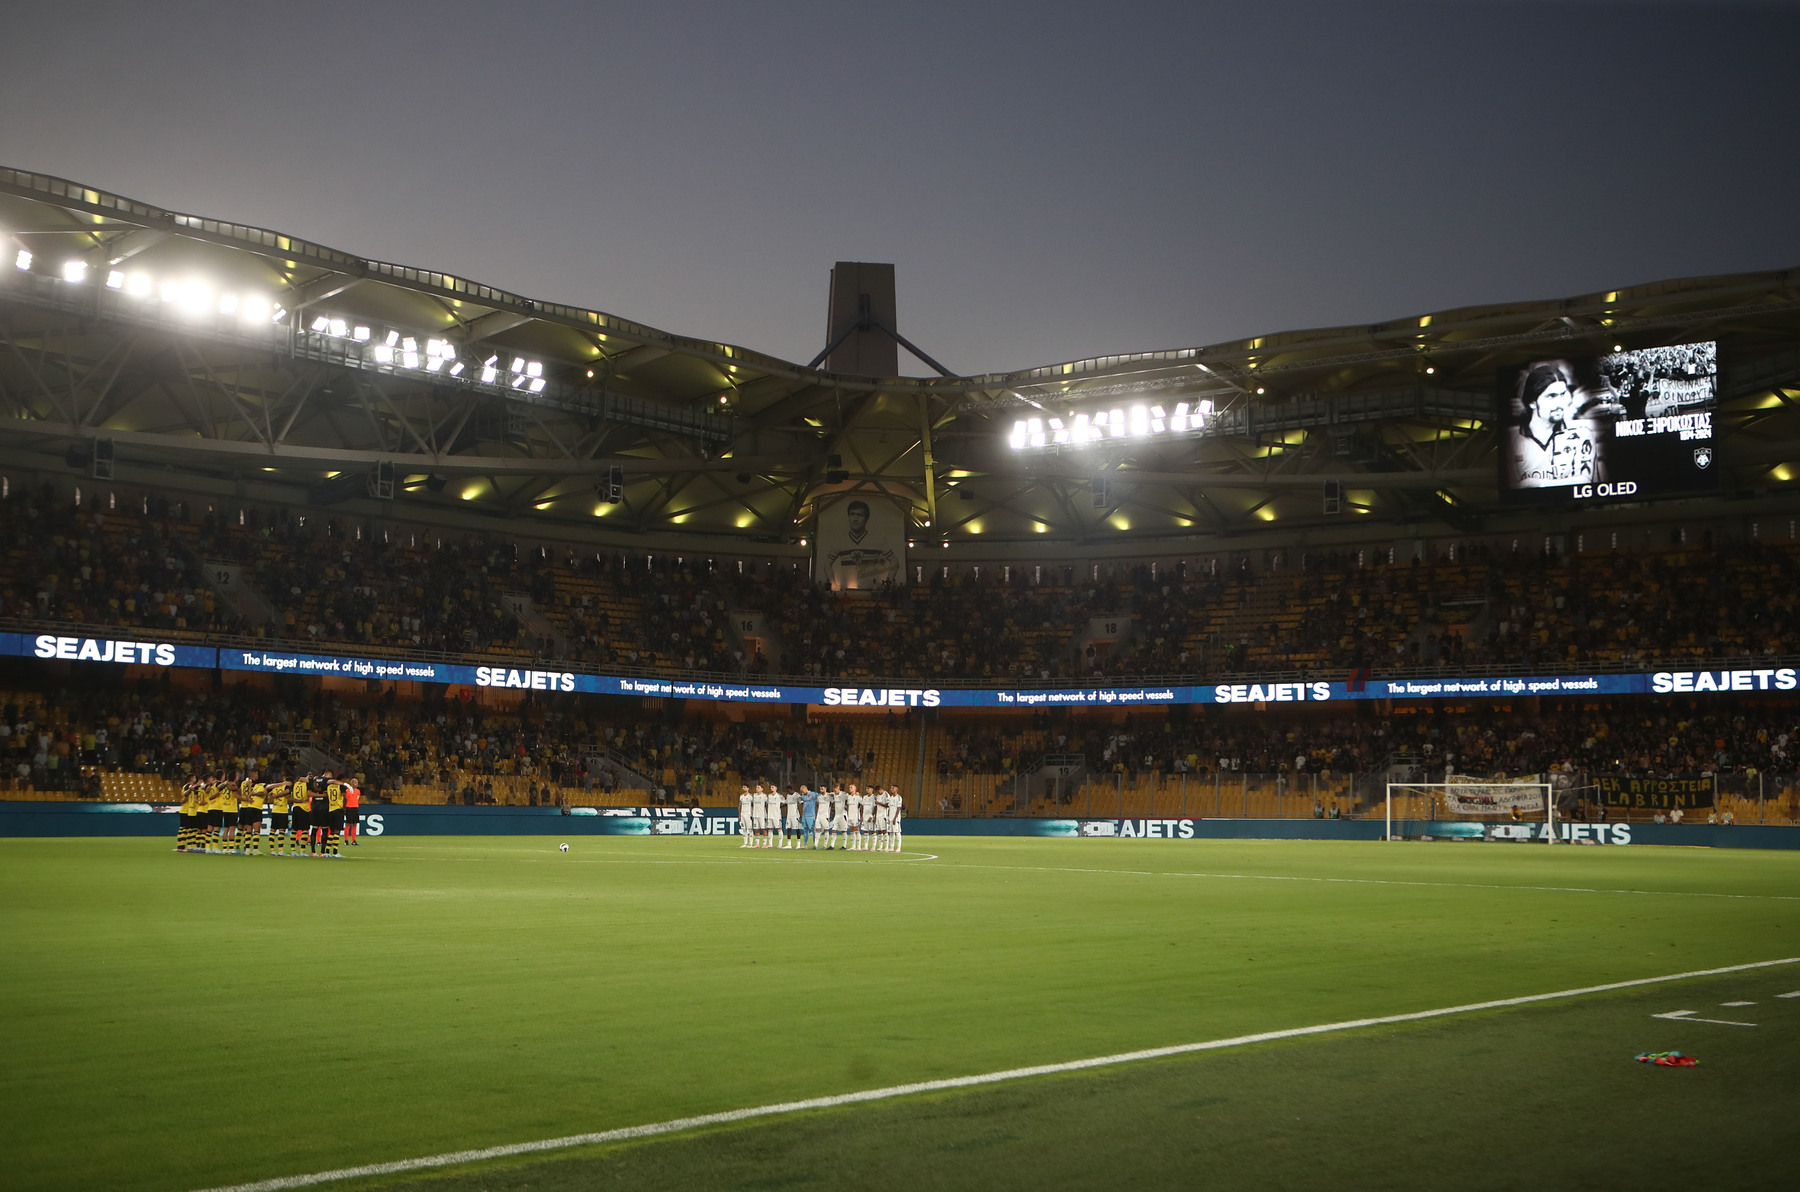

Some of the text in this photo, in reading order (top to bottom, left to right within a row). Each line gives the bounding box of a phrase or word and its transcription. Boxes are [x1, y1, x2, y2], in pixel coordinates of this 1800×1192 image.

[1615, 413, 1712, 437] ΝΙΚΟΣ ΞΗΡΟΚΩΣΤΑΣ
[1573, 481, 1637, 499] LG OLED
[216, 571, 230, 585] 12
[741, 620, 753, 631] 16
[1105, 622, 1117, 634] 18
[35, 635, 175, 666] SEAJETS
[243, 653, 435, 677] The largest network of high speed vessels
[475, 666, 575, 692] SEAJETS
[1387, 678, 1598, 695] The largest network of high speed vessels
[1652, 668, 1797, 693] SEAJETS
[620, 680, 781, 699] The largest network of high speed vessels
[823, 687, 941, 707] SEAJETS
[998, 689, 1174, 704] The largest network of high speed vessels
[1214, 682, 1331, 704] SEAJETS
[295, 785, 303, 799] 21
[329, 788, 338, 801] 19
[1607, 791, 1696, 808] LABRINI
